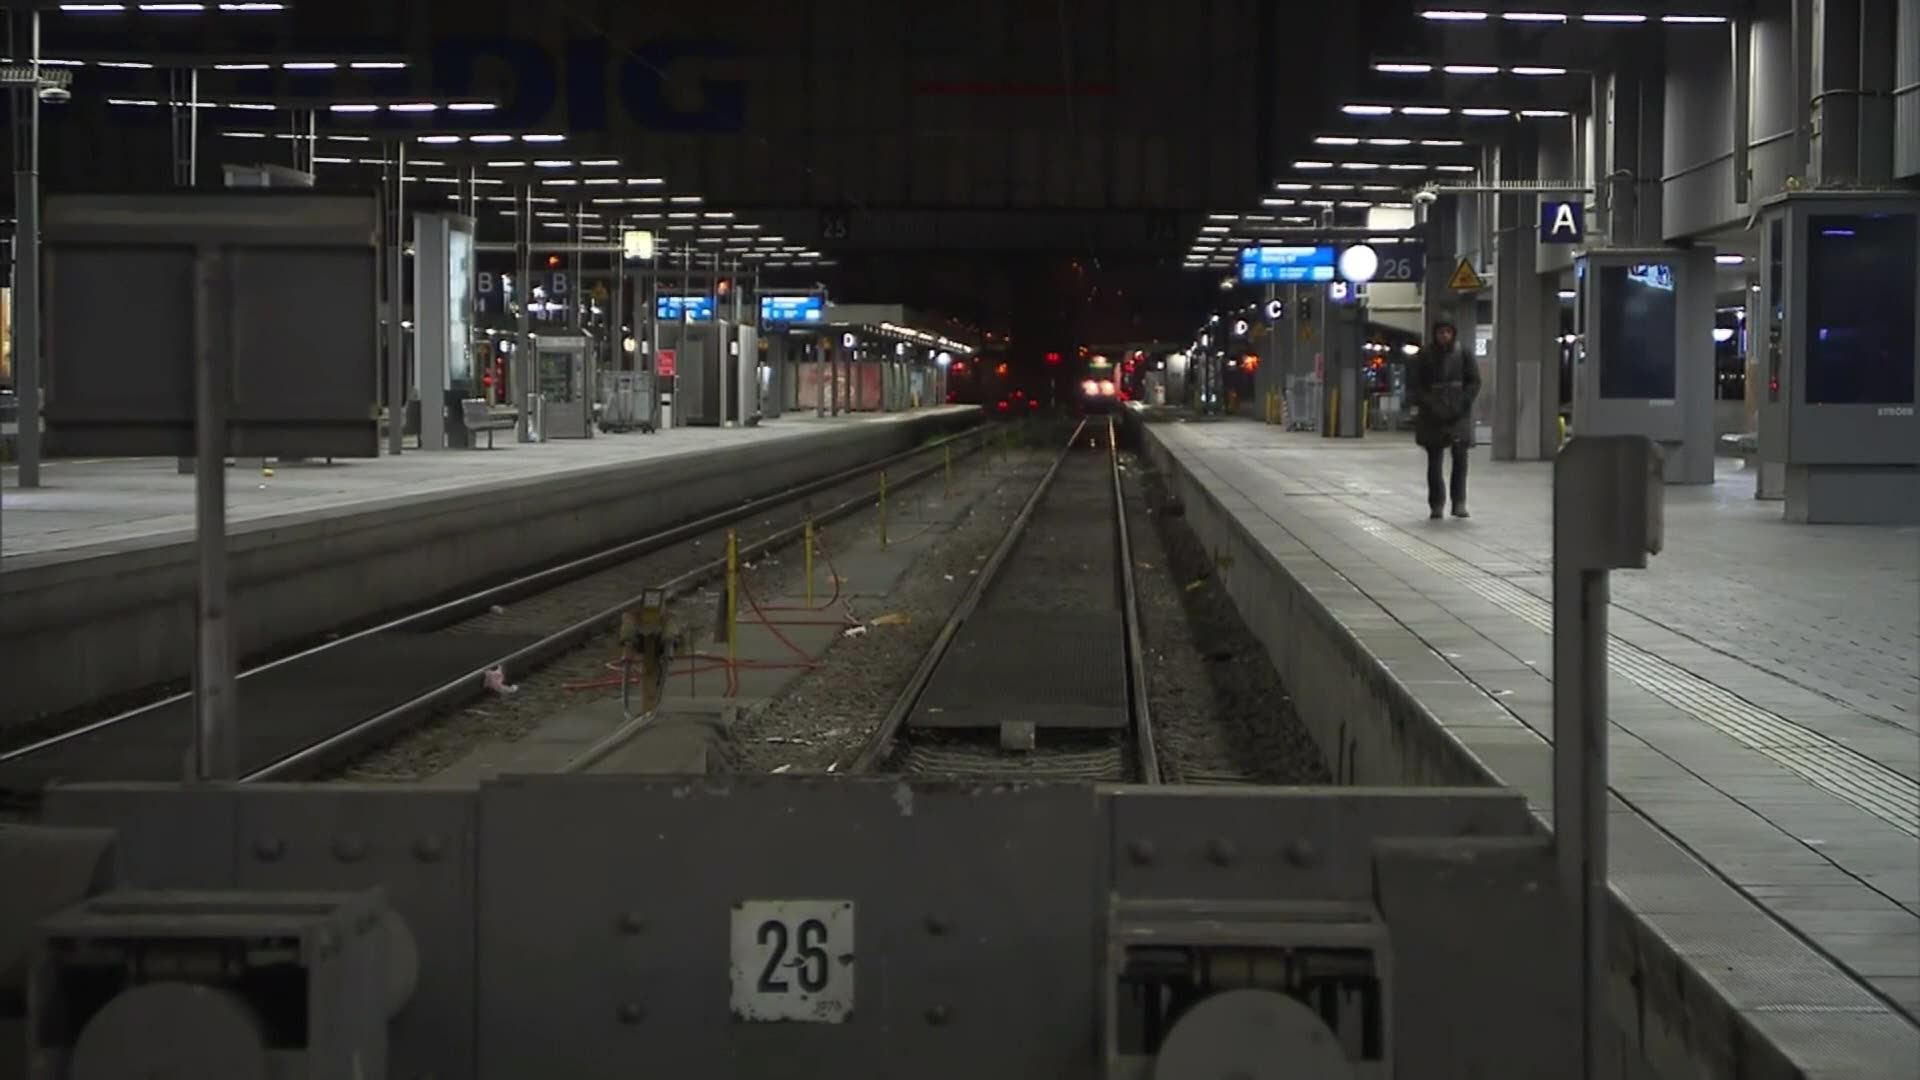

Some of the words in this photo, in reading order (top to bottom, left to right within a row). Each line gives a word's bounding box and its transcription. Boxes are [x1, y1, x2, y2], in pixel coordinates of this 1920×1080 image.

[1552, 203, 1577, 235] A
[1383, 257, 1412, 280] 26
[478, 272, 493, 293] B
[552, 273, 567, 294] B
[1267, 300, 1282, 318] C
[842, 331, 855, 348] D
[757, 918, 828, 993] 26
